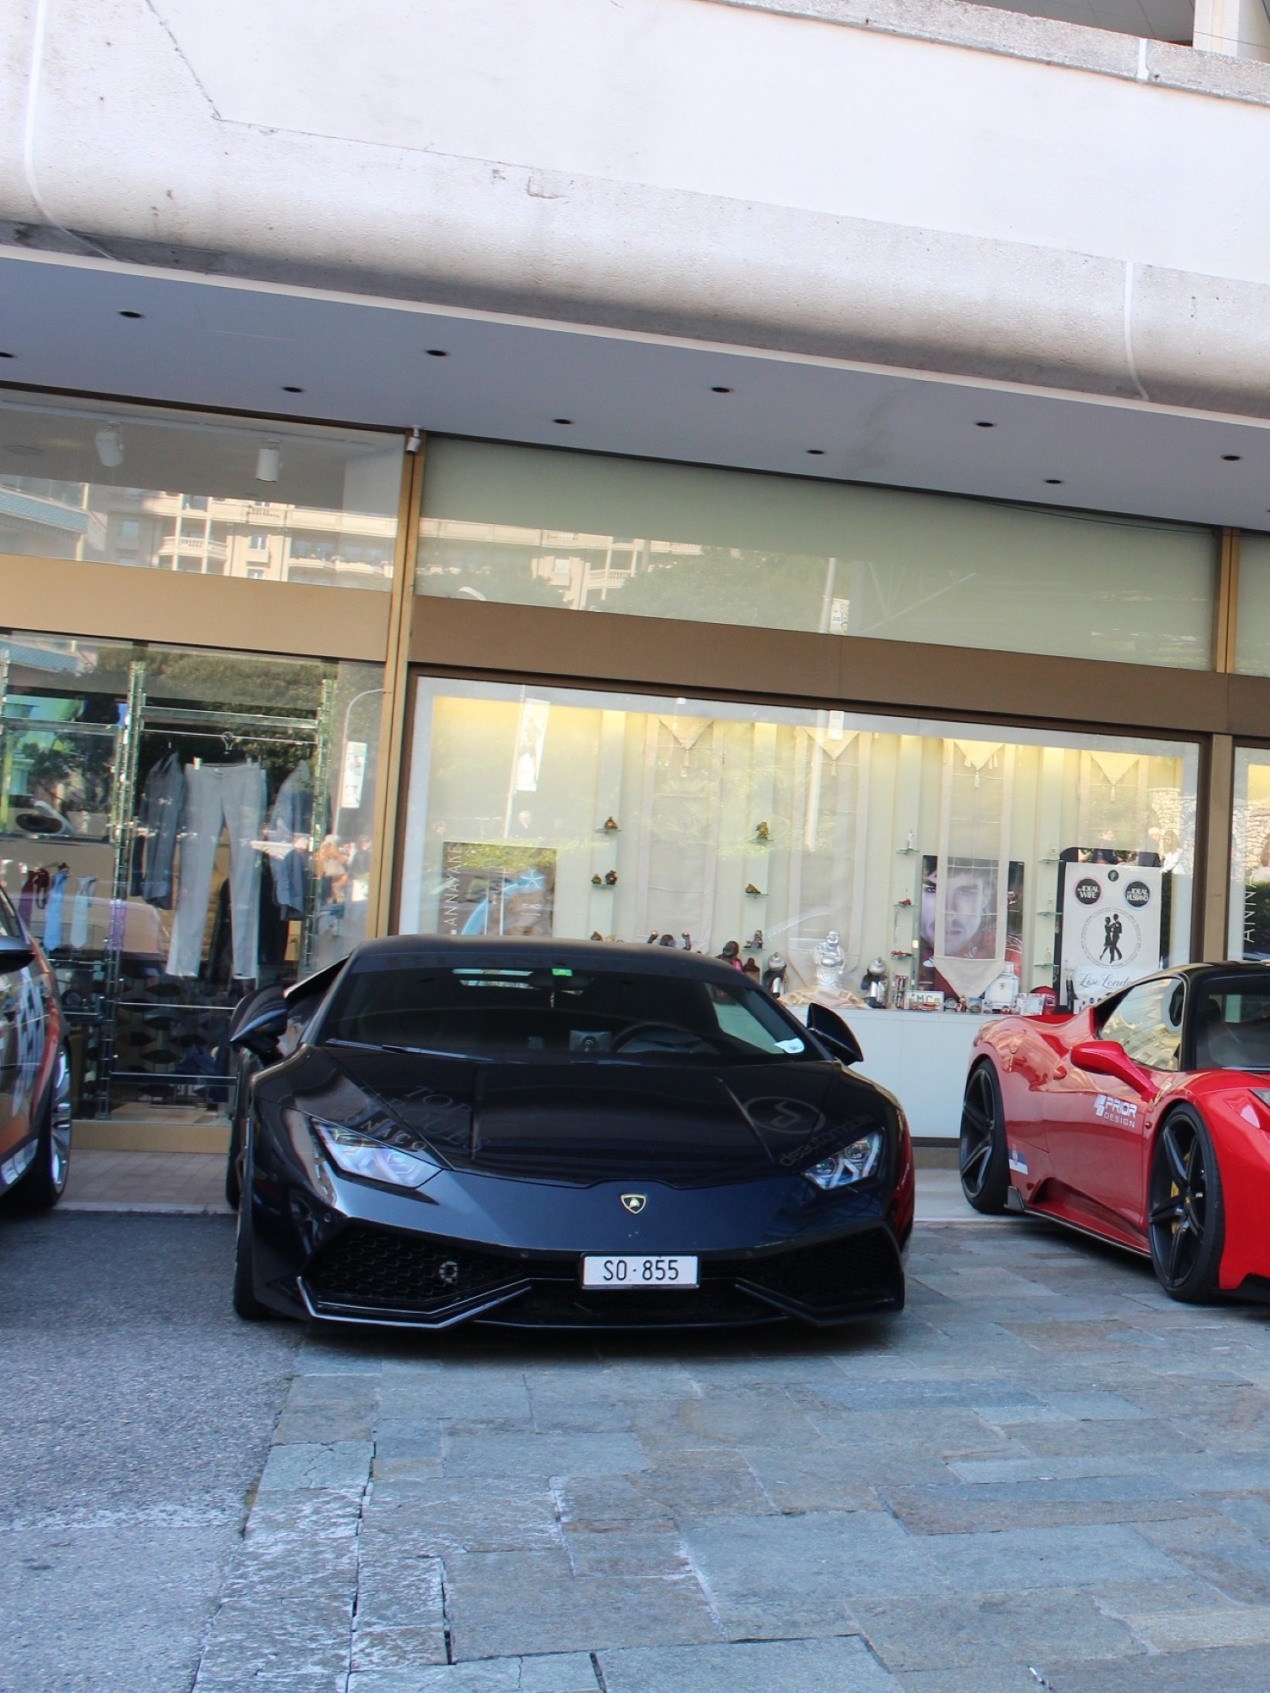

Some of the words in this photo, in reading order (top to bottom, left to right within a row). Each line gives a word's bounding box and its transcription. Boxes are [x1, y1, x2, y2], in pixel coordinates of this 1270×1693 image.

[1105, 1096, 1138, 1118] PRIOR
[1104, 1112, 1136, 1129] DESIGN
[642, 1259, 679, 1281] 855
